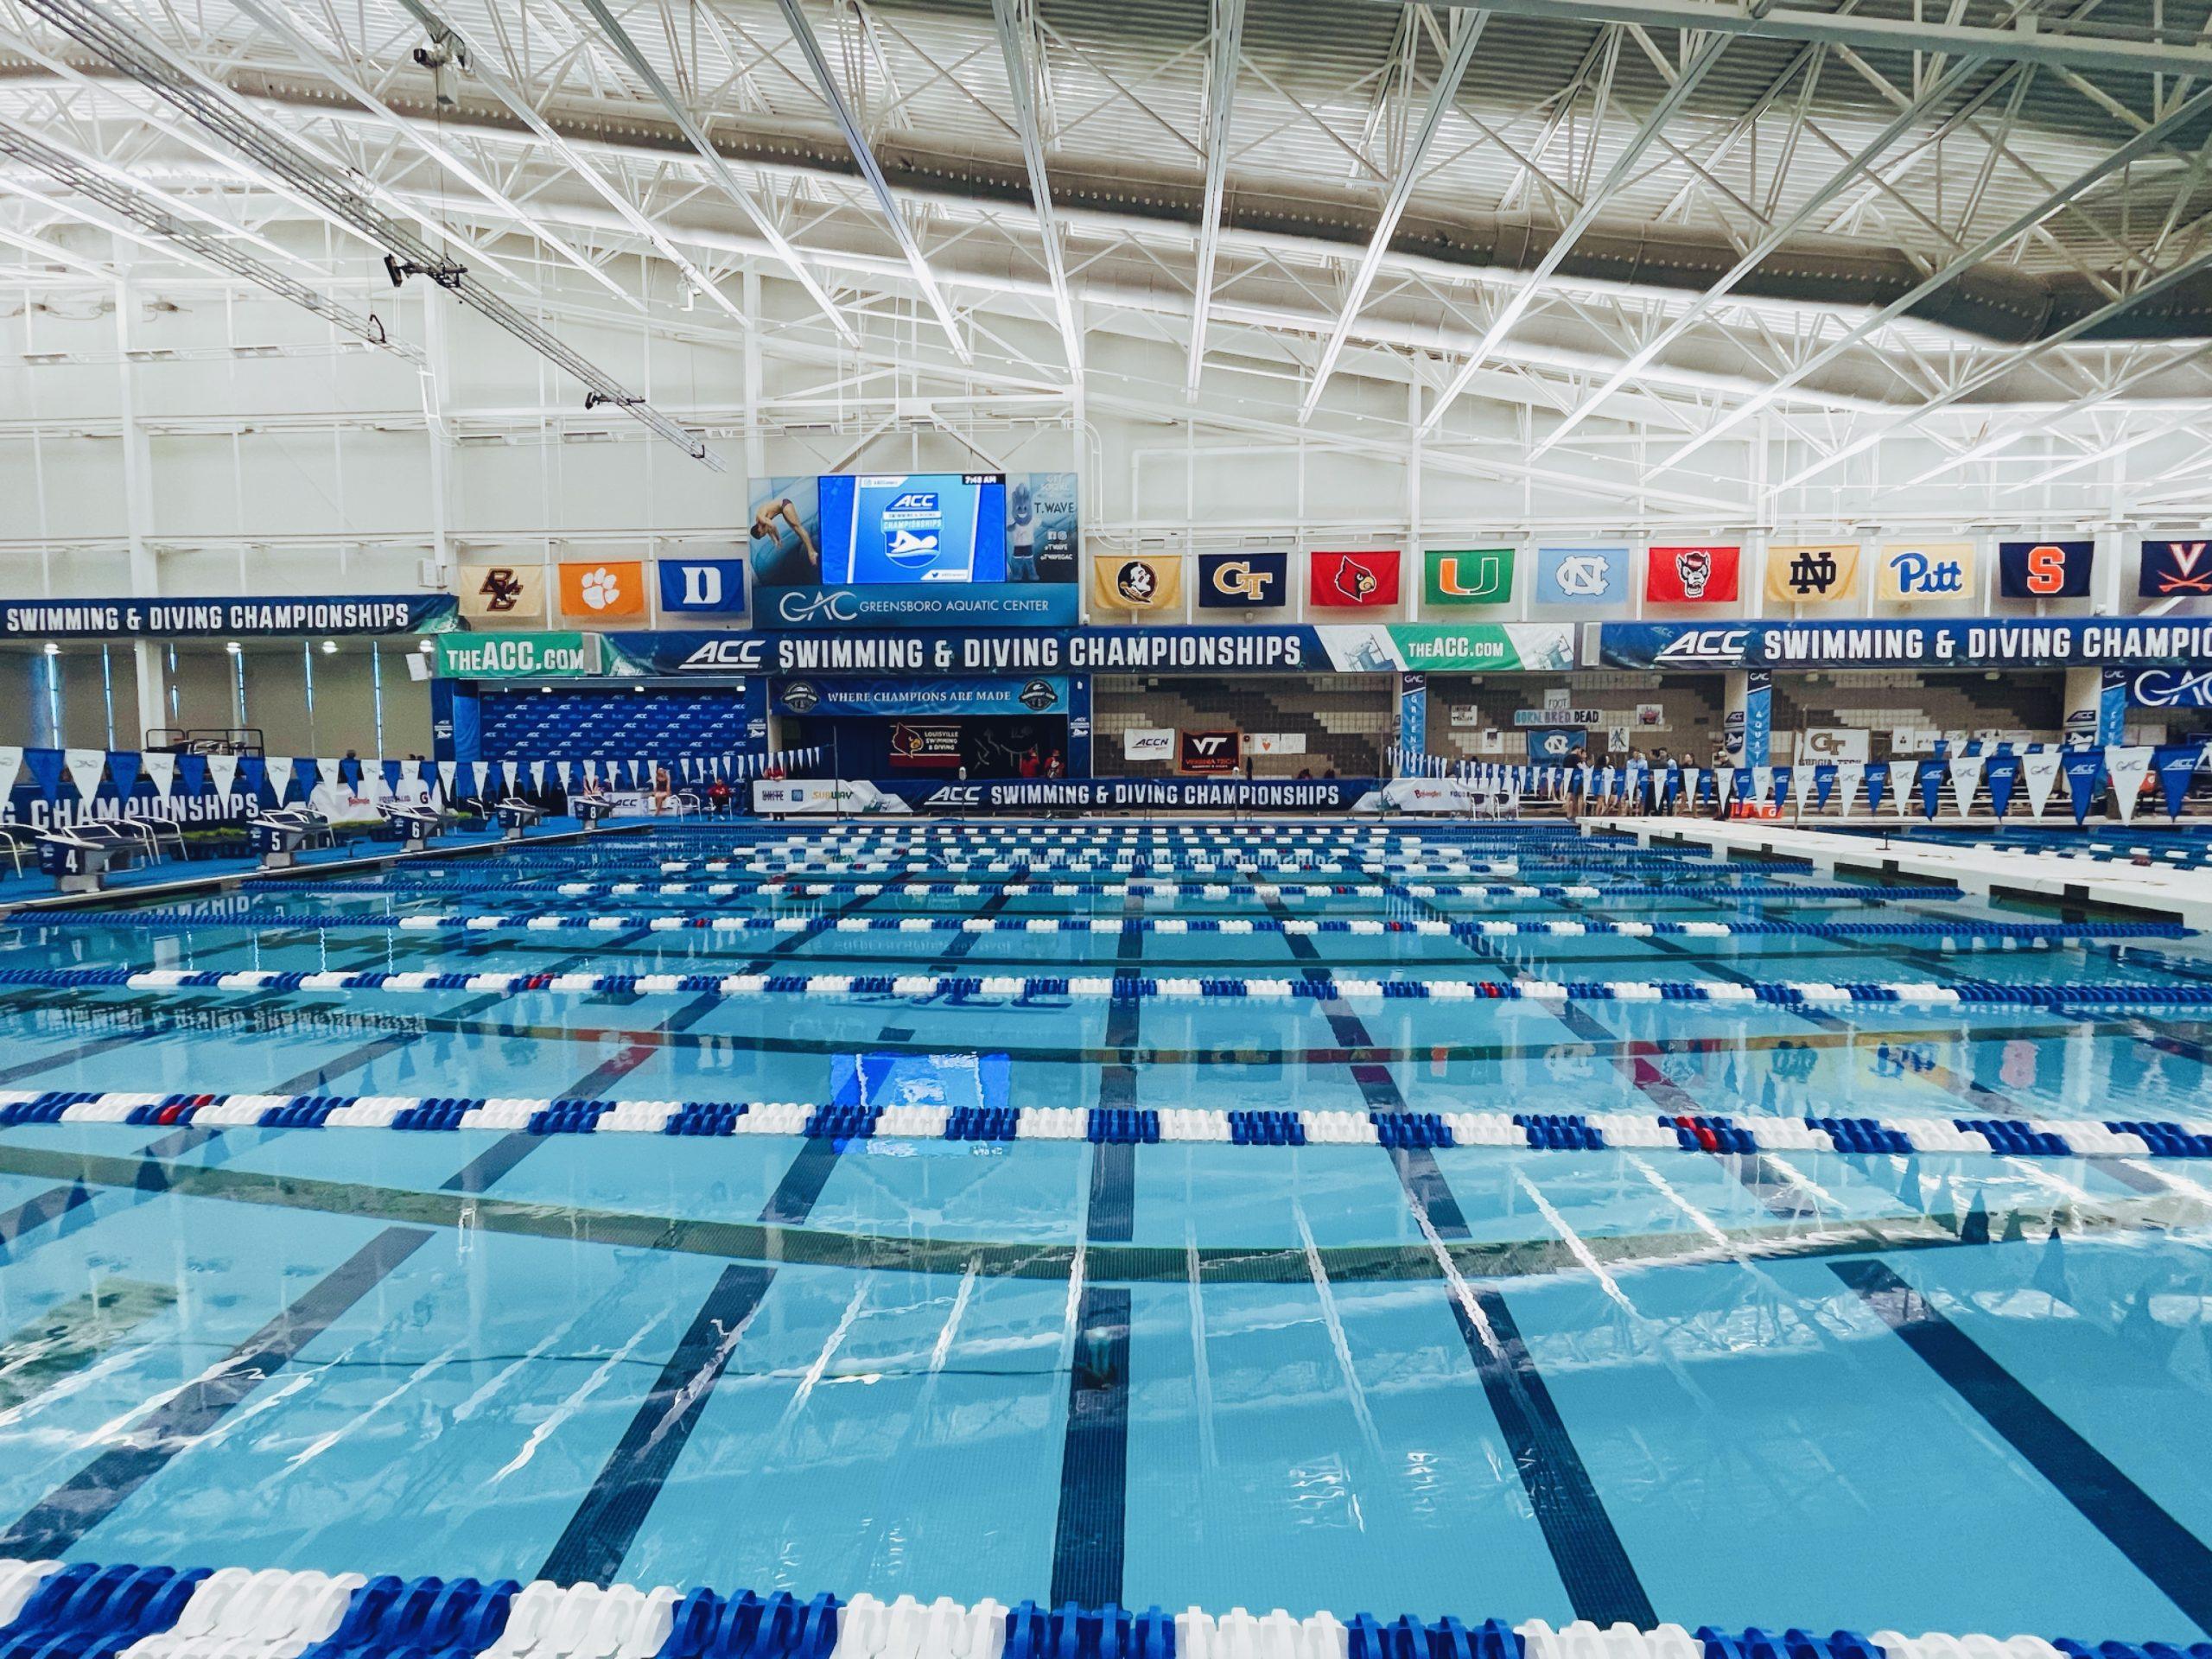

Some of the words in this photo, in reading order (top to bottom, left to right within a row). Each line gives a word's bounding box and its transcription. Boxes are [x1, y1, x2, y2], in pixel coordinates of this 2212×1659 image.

[983, 475, 997, 484] AM
[893, 494, 936, 507] ACC
[2026, 546, 2066, 594] S
[2168, 543, 2207, 578] V
[1212, 562, 1273, 601] GT
[1440, 557, 1499, 596] U
[1890, 552, 1963, 594] Pitt
[681, 566, 722, 605] D
[859, 601, 942, 613] GREENSBORO
[946, 600, 999, 612] AQUATIC
[1002, 600, 1049, 612] CENTER
[6, 607, 118, 632] SWIMMING
[126, 607, 142, 631] &
[149, 605, 223, 631] DIVING
[230, 603, 409, 630] CHAMPIONSHIPS
[684, 639, 766, 664] ACC
[779, 639, 924, 669] SWIMMING
[934, 639, 953, 668] &
[964, 638, 1058, 667] DIVING
[1070, 635, 1301, 666] CHAMPIONSHIPS
[1408, 637, 1504, 658] THEACC.COM
[1662, 630, 1751, 655] ACC
[1764, 629, 1923, 660] SWIMMING
[1936, 629, 1955, 658] &
[1968, 626, 2071, 658] DIVING
[446, 640, 584, 671] THEACC.COM
[827, 692, 872, 702] WHERE
[874, 691, 947, 702] CHAMPIONS
[950, 691, 973, 701] ARE
[976, 691, 1011, 701] MADE
[1573, 710, 1599, 723] DEAD
[1192, 737, 1228, 755] VT
[1753, 710, 1763, 768] AQUATI
[615, 798, 639, 807] ACC
[928, 785, 982, 802] ACC
[990, 785, 1090, 805] SWIMMING
[1096, 785, 1109, 804] &
[1115, 784, 1178, 804] DIVING
[1184, 785, 1339, 805] CHAMPIONSHIPS
[515, 812, 521, 827] 7
[590, 806, 597, 819] 8
[411, 821, 420, 839] 6
[271, 831, 281, 851] 5
[66, 849, 78, 873] 4
